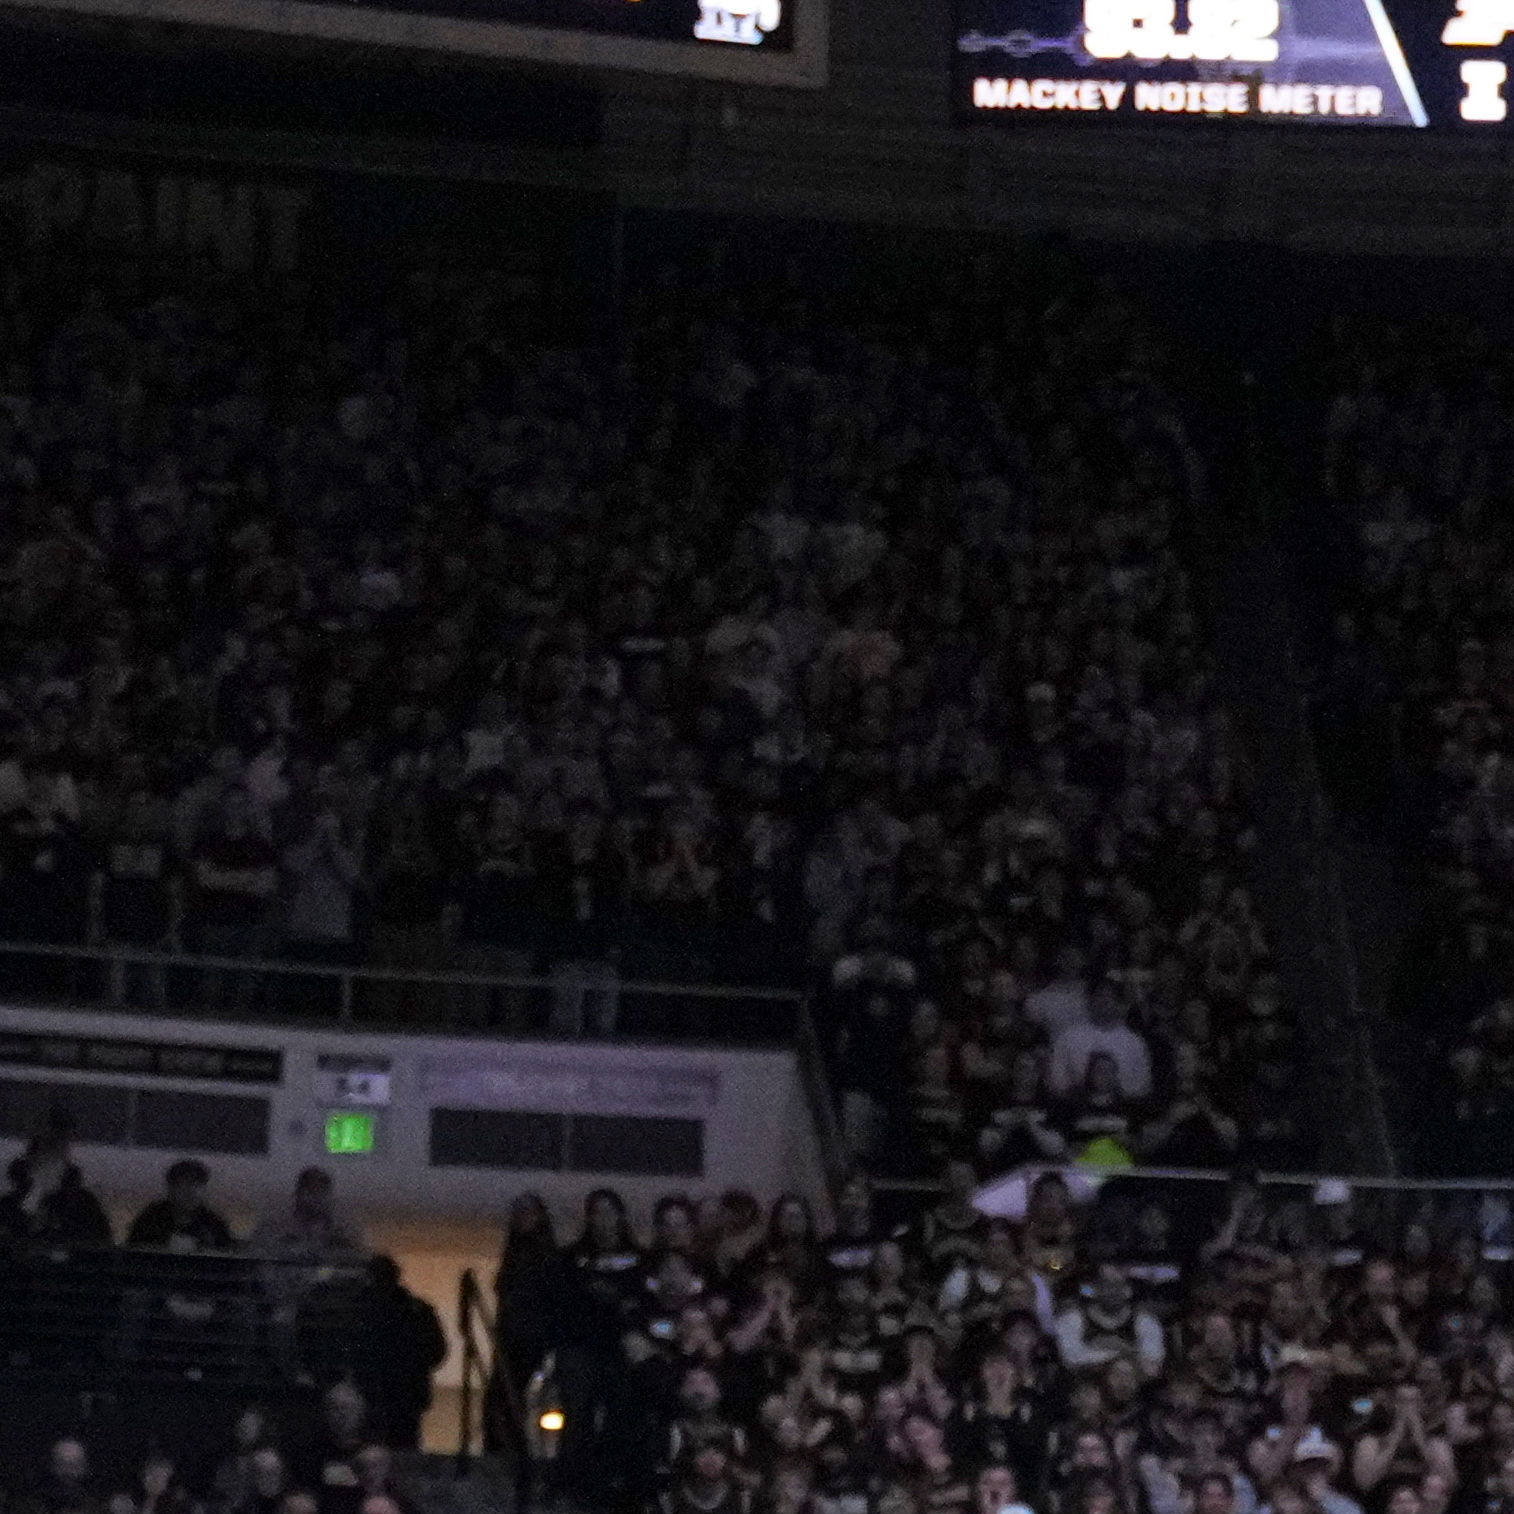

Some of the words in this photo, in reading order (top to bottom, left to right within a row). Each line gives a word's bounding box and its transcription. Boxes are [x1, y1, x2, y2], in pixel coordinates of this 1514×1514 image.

[973, 78, 1126, 110] MACKEY
[1135, 81, 1249, 113] NOISE
[1259, 83, 1384, 116] METER
